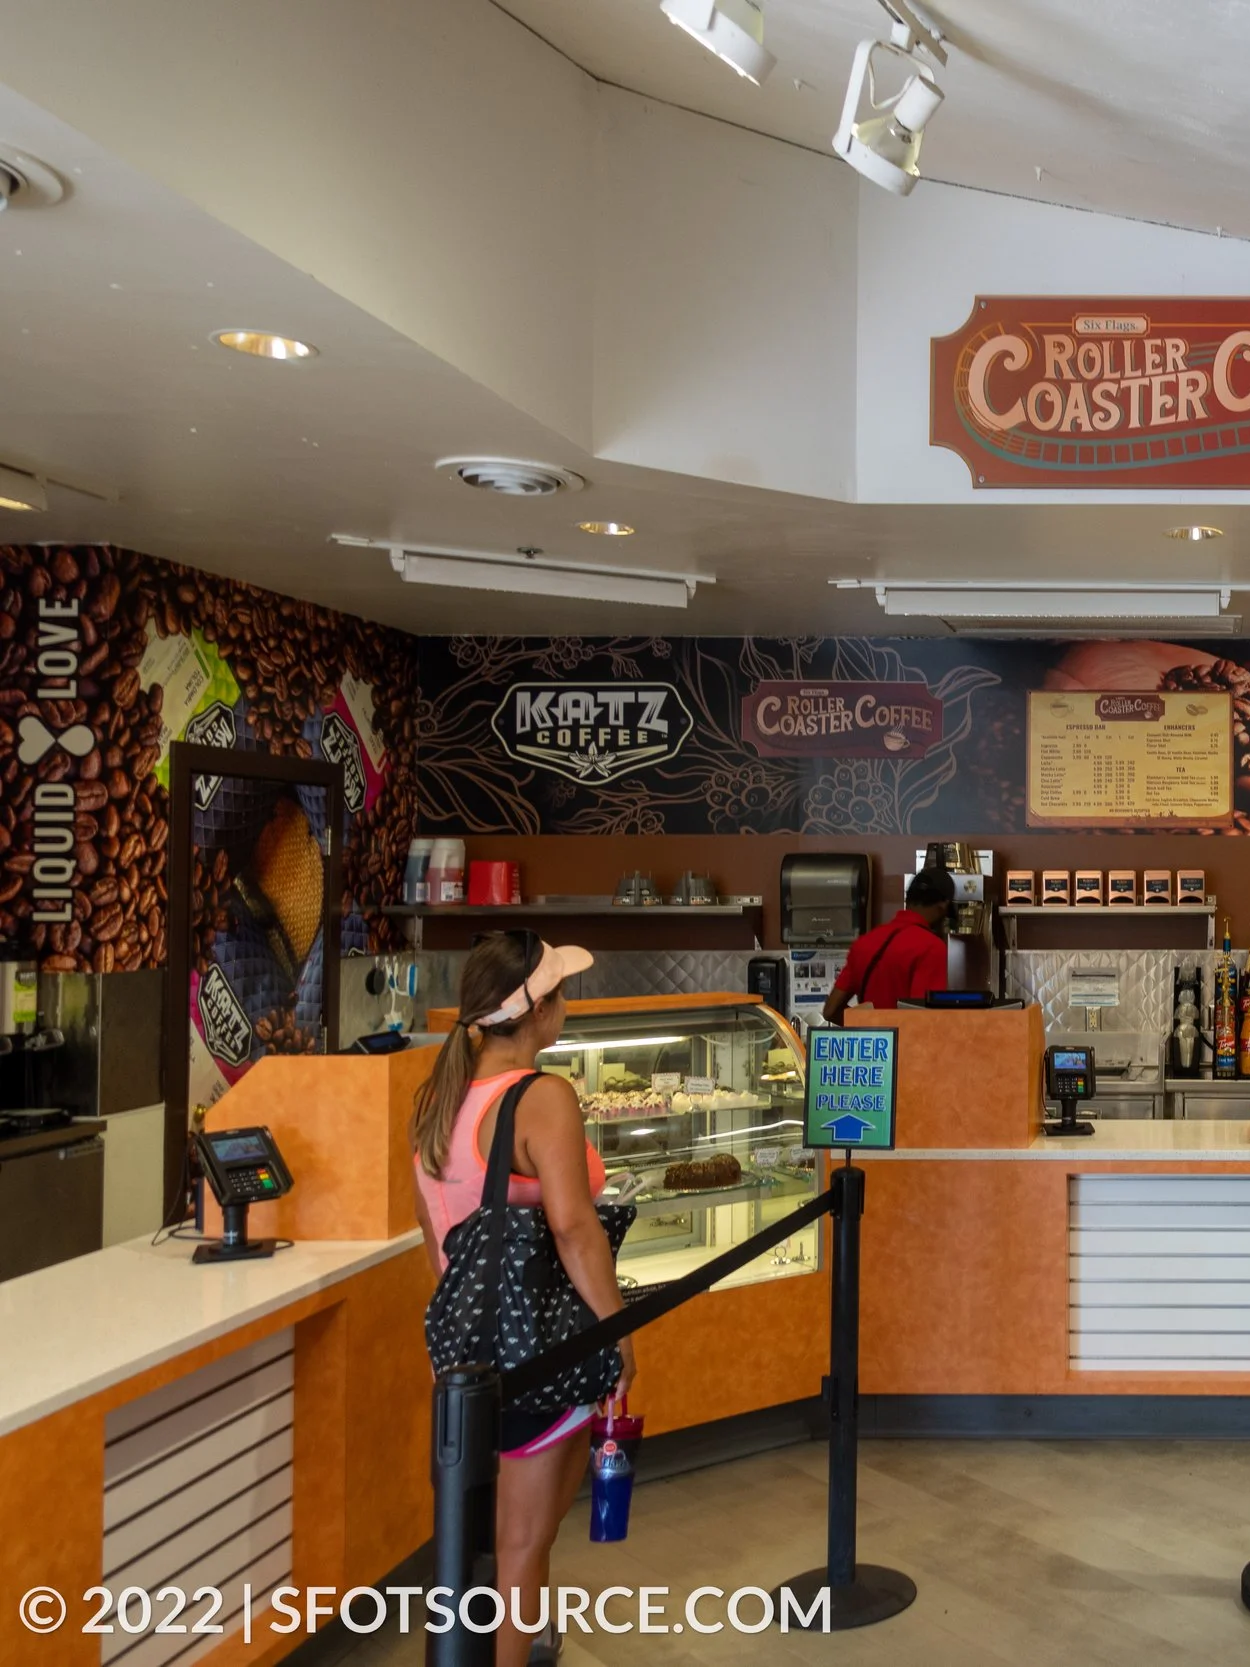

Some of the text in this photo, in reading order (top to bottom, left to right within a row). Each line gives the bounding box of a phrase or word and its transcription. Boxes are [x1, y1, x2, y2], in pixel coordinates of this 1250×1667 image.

[1084, 320, 1136, 331] Six Flags
[1044, 334, 1190, 380] ROLLER
[968, 335, 1211, 433] COASTER
[37, 598, 79, 699] LOVE
[516, 691, 669, 735] KATZ
[757, 695, 934, 736] COASTER COFFEE
[788, 695, 844, 715] ROLLER
[537, 728, 648, 746] COFFEE
[33, 782, 75, 923] LIQUID
[204, 972, 250, 1051] KATZ
[206, 996, 238, 1048] COFFEE
[814, 1037, 888, 1061] ENTER
[821, 1065, 884, 1087] HERE
[816, 1094, 885, 1111] PLEASE
